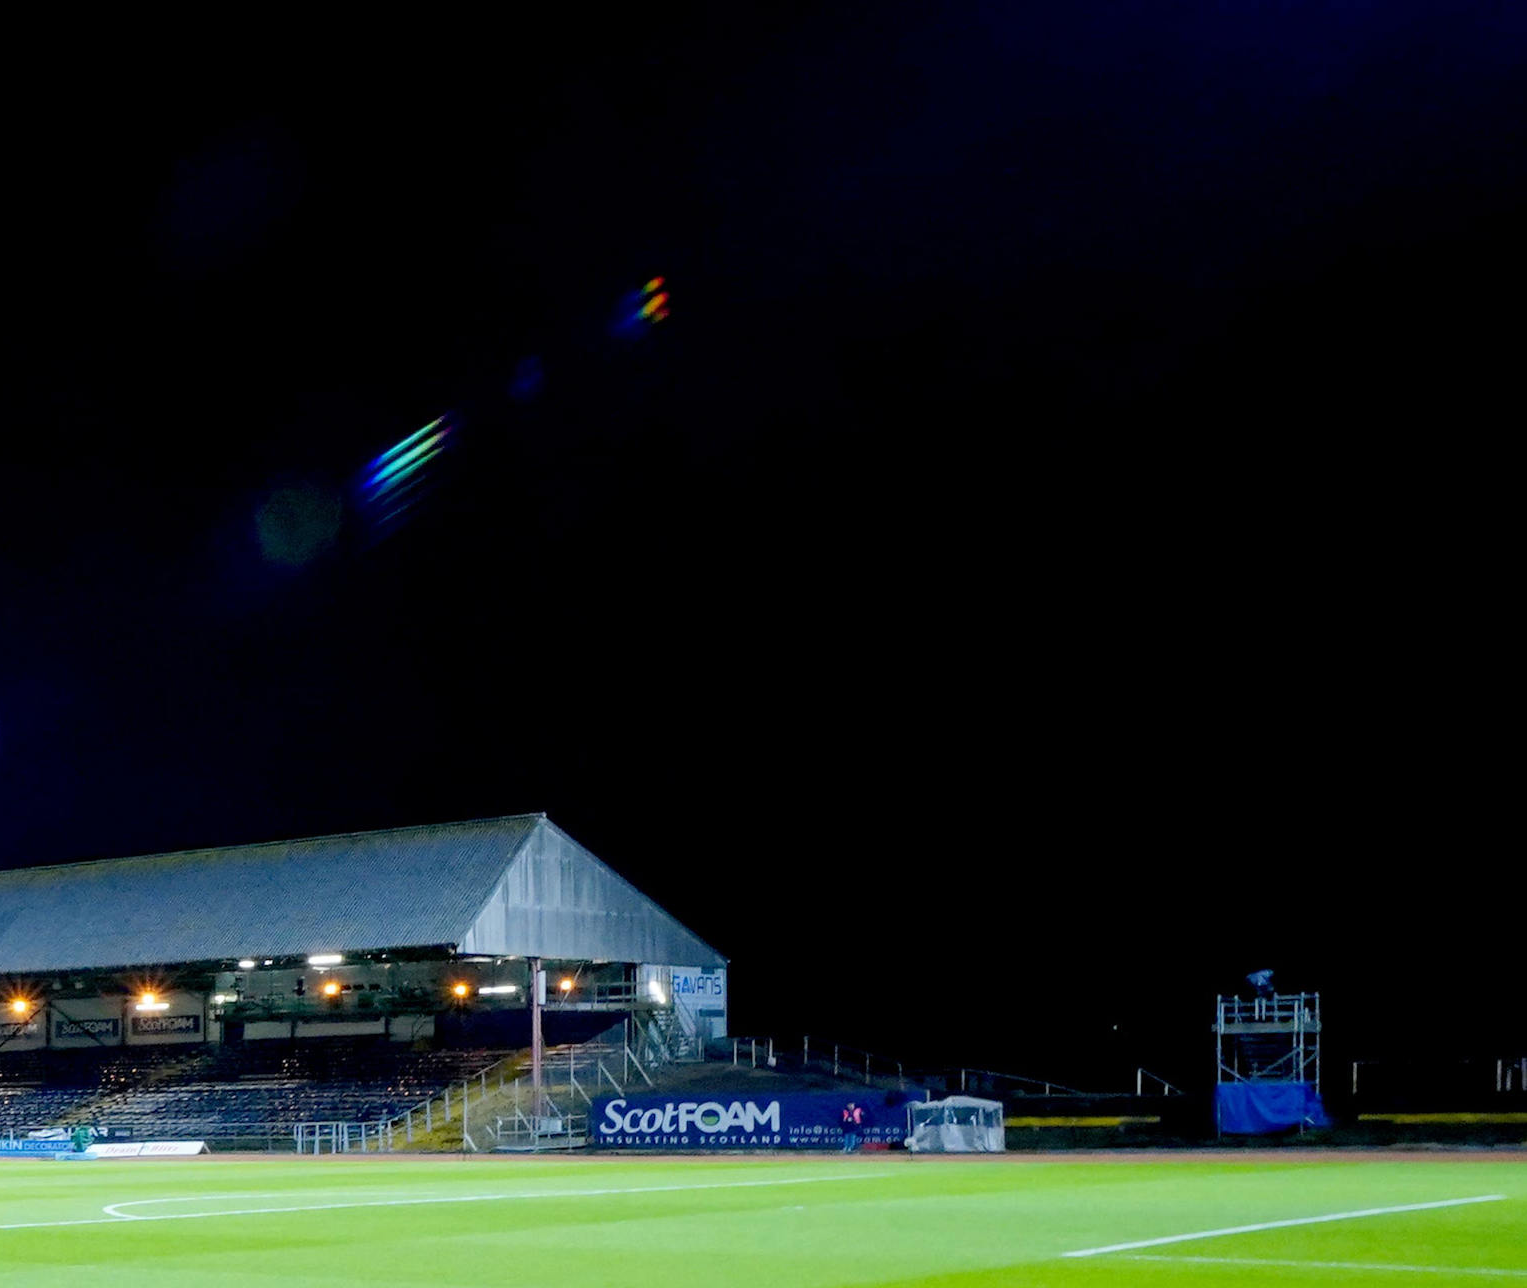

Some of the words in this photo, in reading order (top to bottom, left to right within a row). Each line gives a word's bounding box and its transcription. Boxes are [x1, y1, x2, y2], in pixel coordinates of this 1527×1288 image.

[599, 1099, 780, 1134] ScotFOAM
[599, 1135, 689, 1145] INSULATING
[700, 1135, 781, 1144] SCOTLAND
